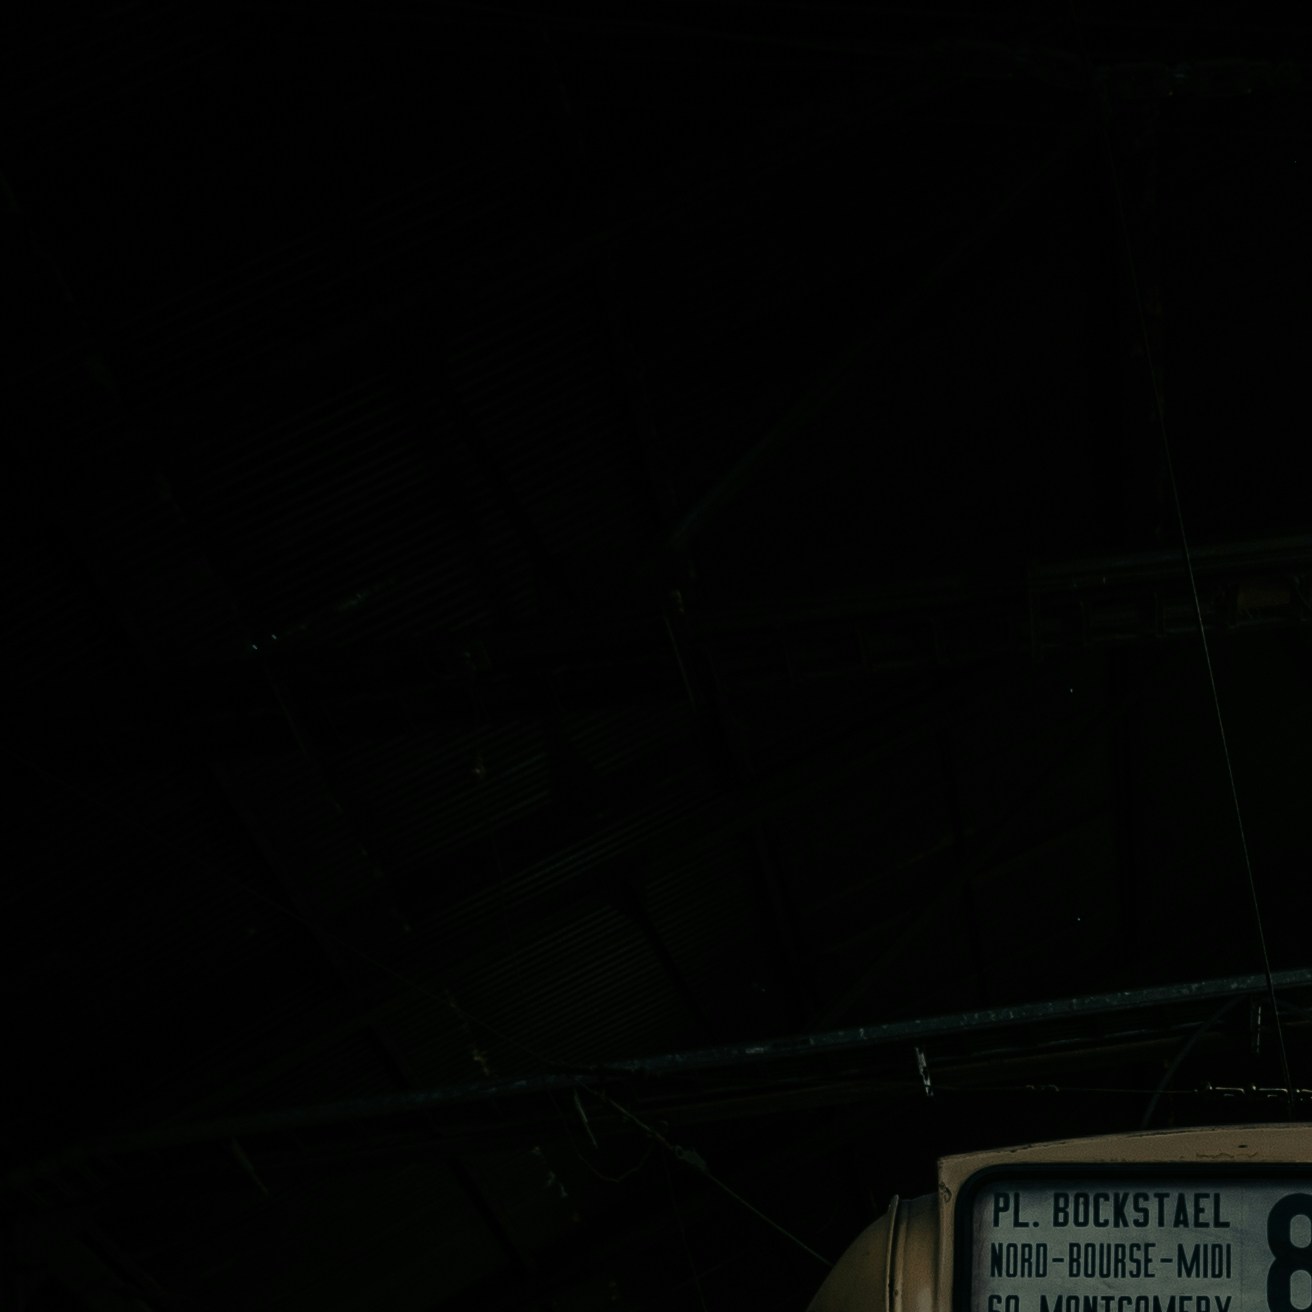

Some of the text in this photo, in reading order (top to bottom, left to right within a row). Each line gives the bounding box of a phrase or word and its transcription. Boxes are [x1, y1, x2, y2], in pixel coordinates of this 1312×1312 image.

[992, 1191, 1232, 1229] PL. BOCKSTAEL
[989, 1242, 1232, 1279] NORD-BOURSE-MIDI
